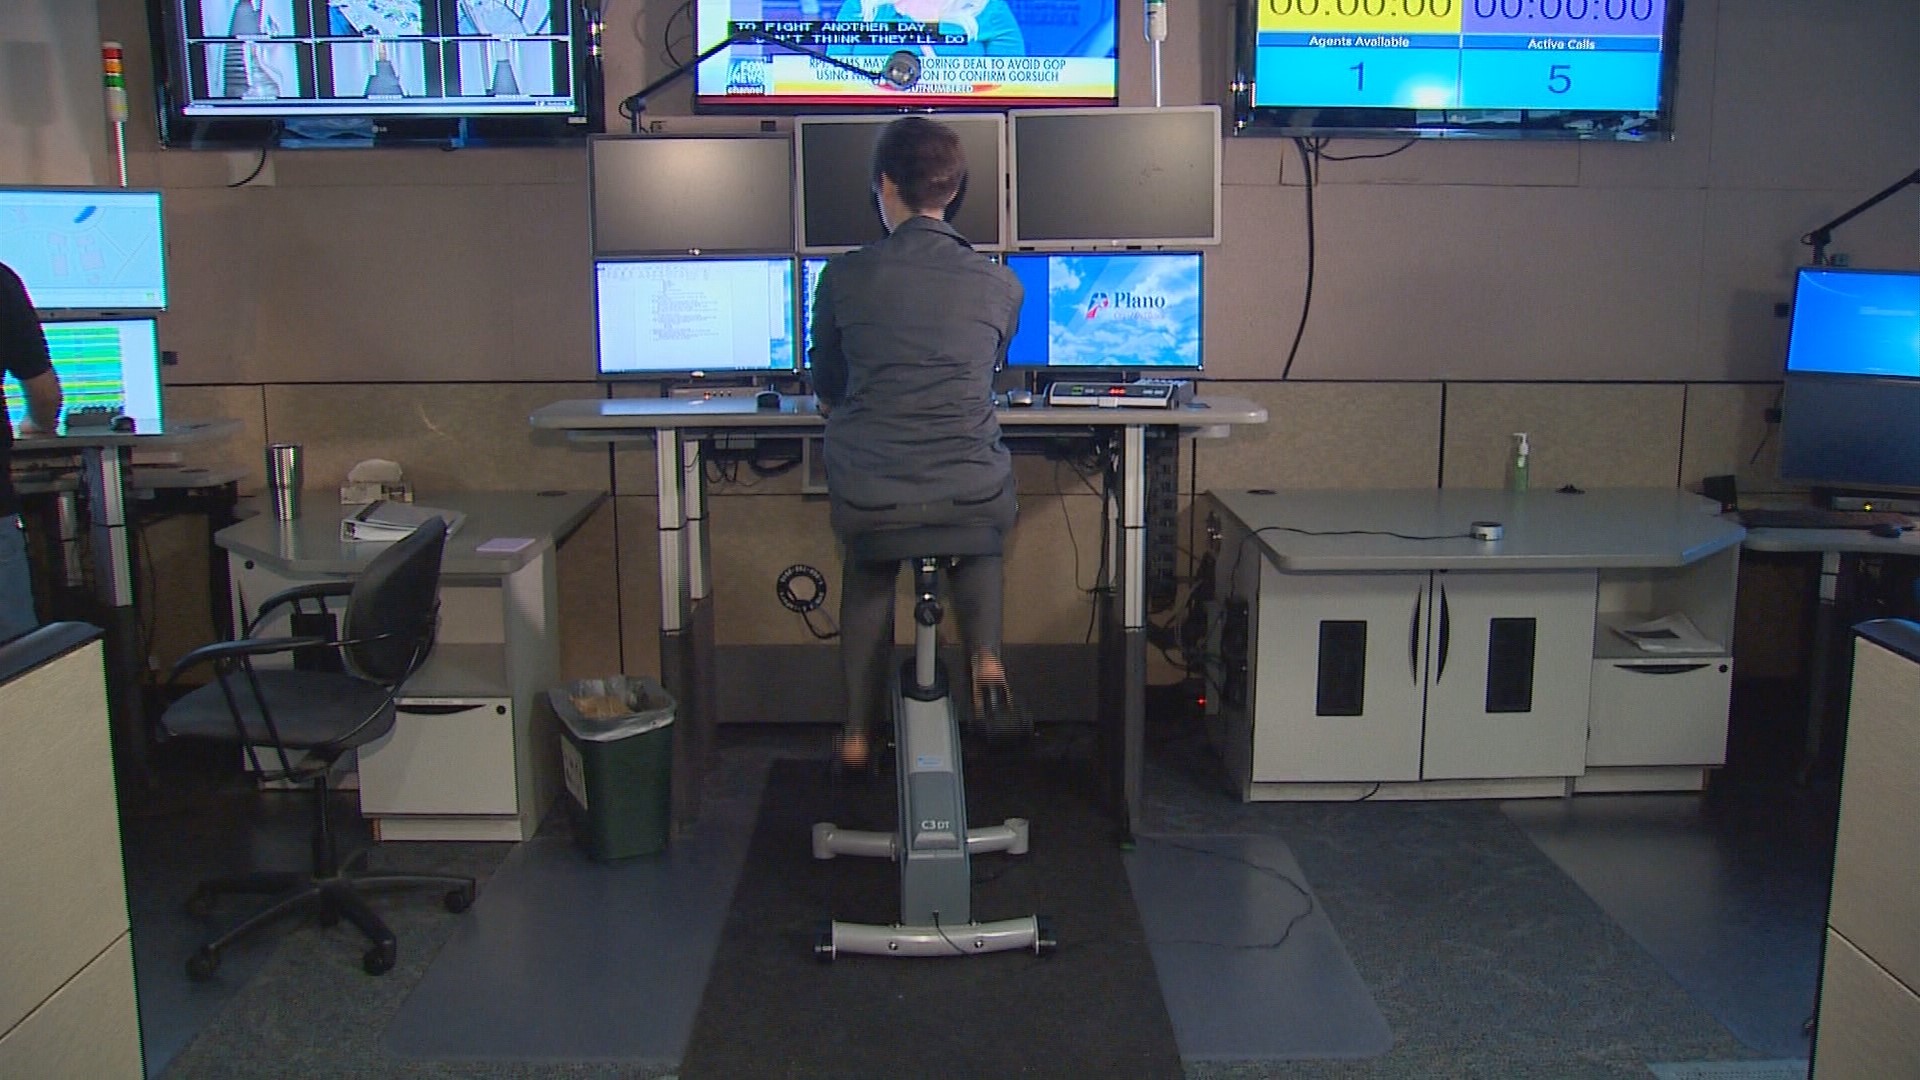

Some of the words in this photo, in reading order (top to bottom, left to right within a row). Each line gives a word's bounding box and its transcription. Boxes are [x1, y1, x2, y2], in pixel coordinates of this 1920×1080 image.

[1474, 0, 1653, 20] 00:00:00
[764, 22, 813, 32] FIGHT
[821, 22, 889, 32] ANOTHER
[813, 34, 860, 44] THINK
[868, 34, 936, 44] THEY'LL
[945, 34, 965, 44] DO
[1308, 35, 1352, 48] Agents
[1354, 36, 1410, 48] Available
[1527, 38, 1565, 50] Active
[1567, 39, 1596, 50] Calls
[963, 58, 988, 70] DEAL
[990, 58, 1005, 70] TO
[1007, 58, 1041, 70] AVOID
[1043, 58, 1067, 70] GOP
[816, 70, 849, 81] USING
[942, 70, 957, 82] TO
[959, 70, 1006, 82] CONFIRM
[1008, 70, 1060, 82] GORSUCH
[1349, 61, 1364, 92] 1
[1548, 64, 1572, 94] 5
[1114, 291, 1166, 308] Plano
